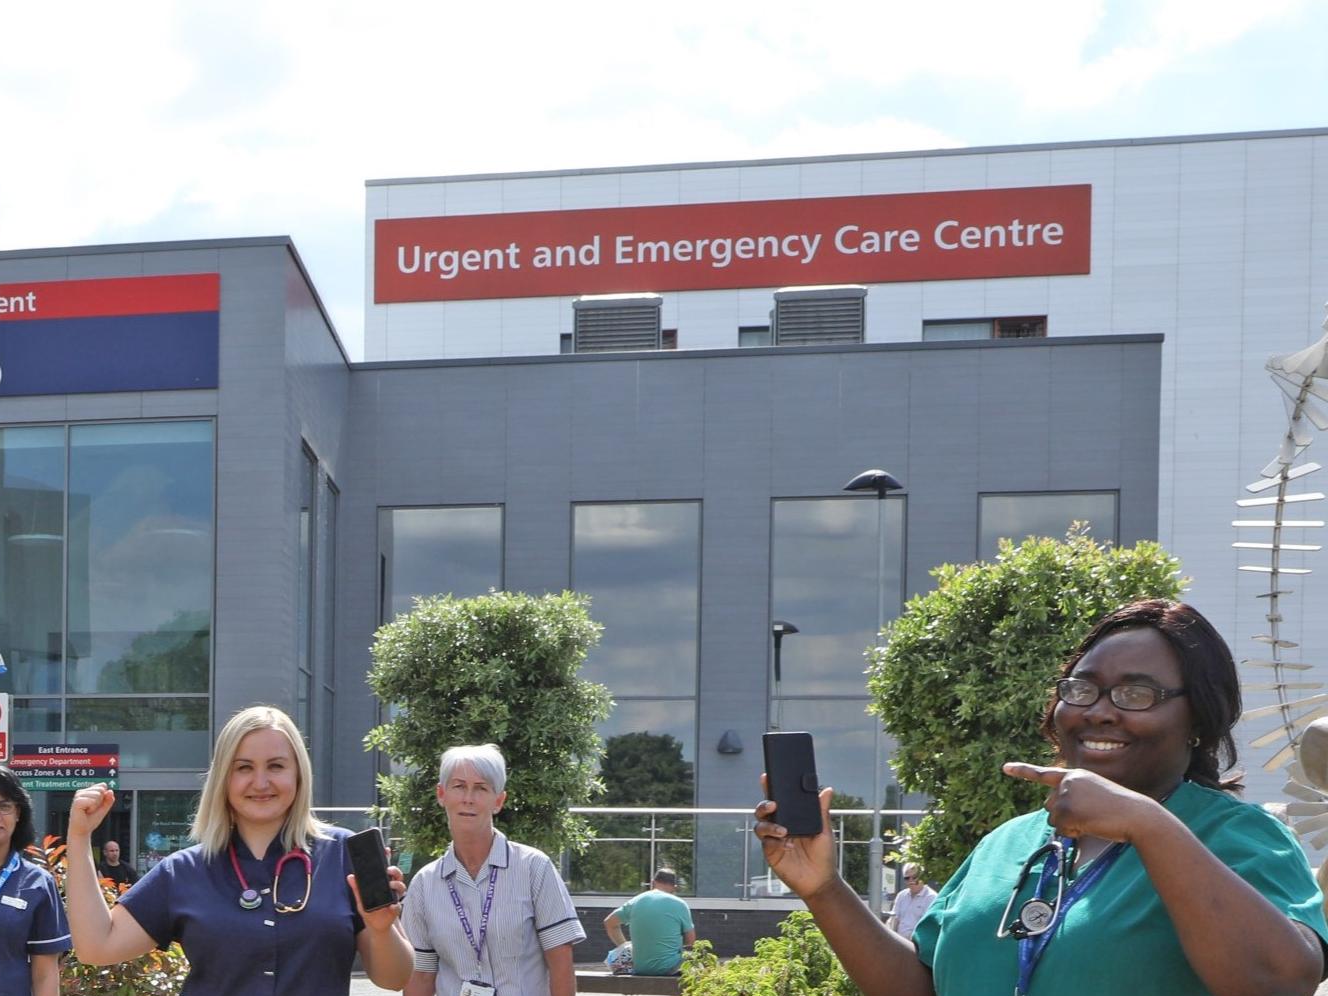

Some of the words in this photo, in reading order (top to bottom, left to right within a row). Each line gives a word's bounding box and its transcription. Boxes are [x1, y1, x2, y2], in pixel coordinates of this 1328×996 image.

[397, 242, 521, 280] Urgent
[532, 235, 601, 268] and
[614, 230, 823, 267] Emergency
[834, 223, 921, 255] Care
[933, 217, 1064, 250] Centre
[38, 746, 54, 754] East
[55, 746, 88, 754] Entrance
[49, 757, 91, 766] Department
[34, 769, 55, 777] Zones
[74, 768, 81, 776] C
[88, 768, 95, 776] D
[35, 780, 70, 788] Treatment
